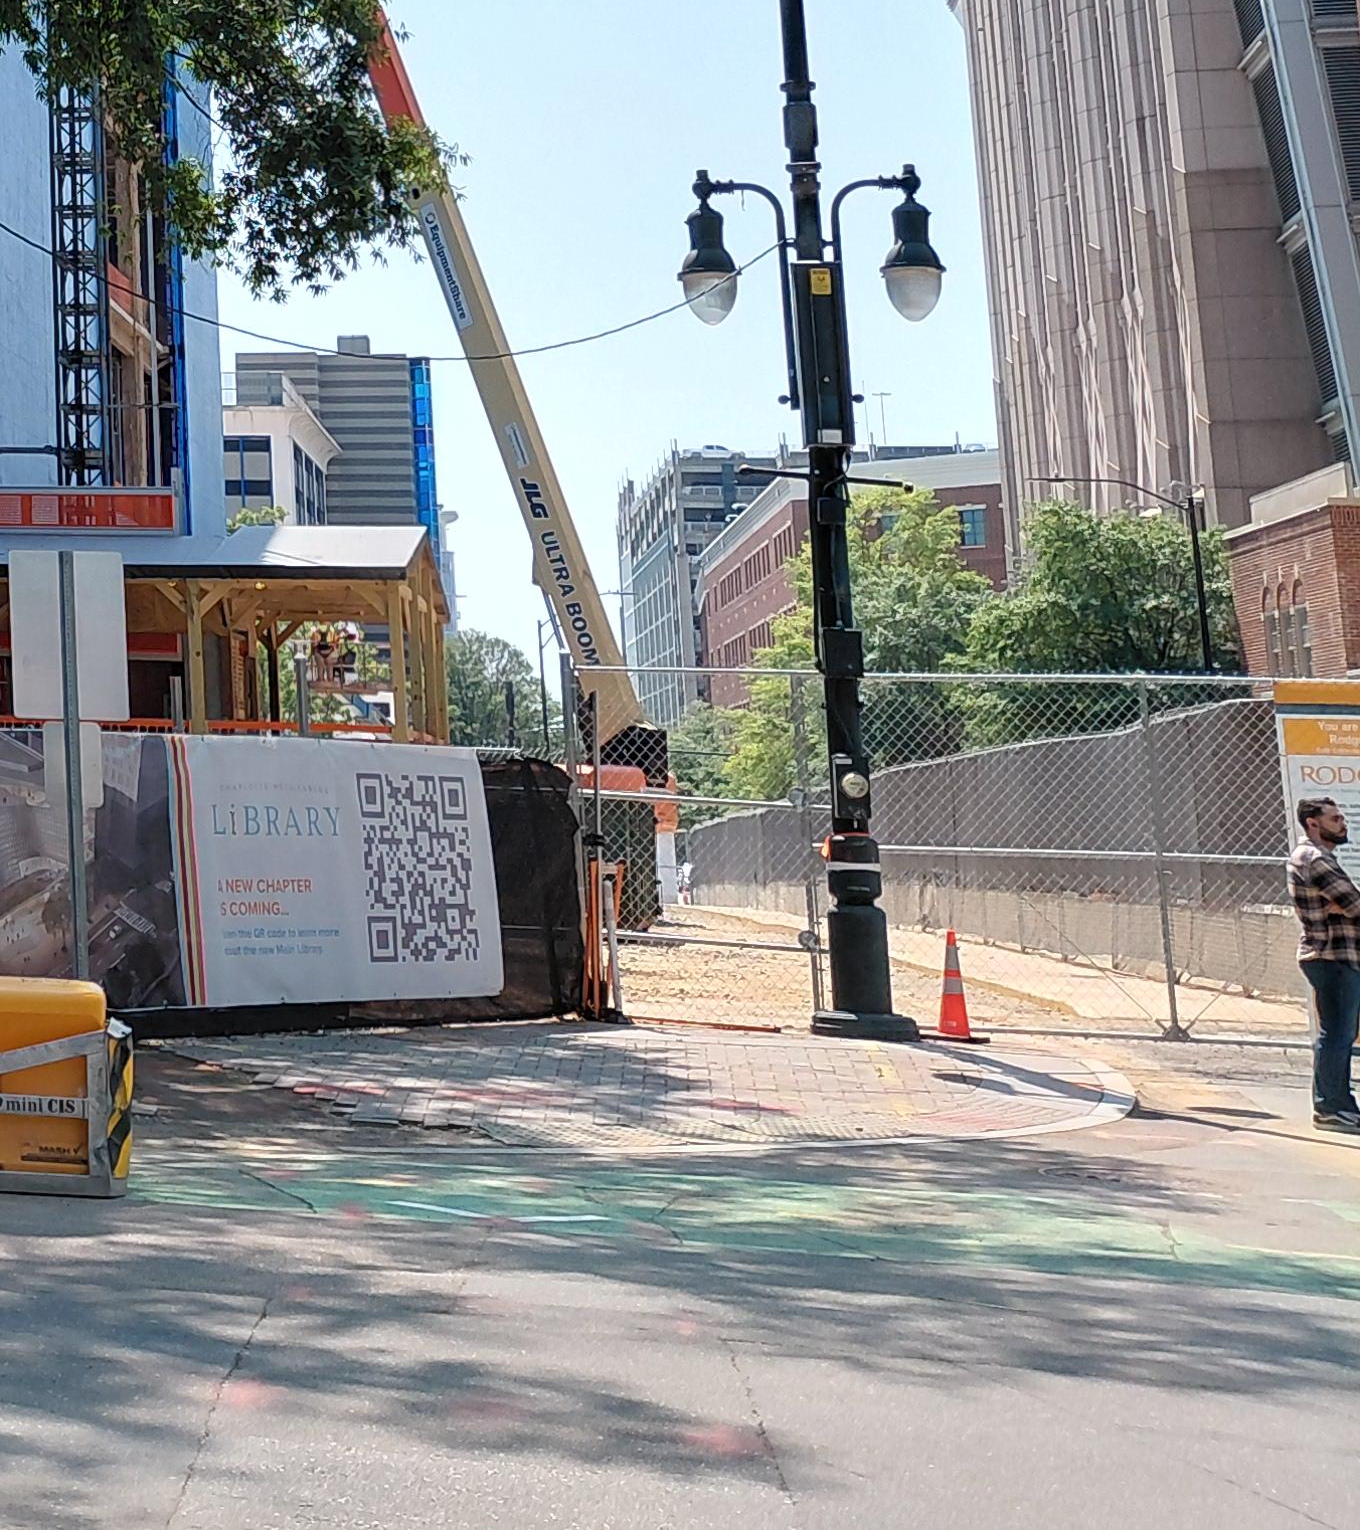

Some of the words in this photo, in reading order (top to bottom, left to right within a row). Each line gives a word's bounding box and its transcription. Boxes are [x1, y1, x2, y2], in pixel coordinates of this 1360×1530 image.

[429, 223, 467, 320] EquipmentShare
[520, 477, 550, 519] JLG
[540, 531, 576, 598] ULTRA
[565, 601, 601, 666] BOOM
[1318, 720, 1339, 731] You
[1341, 723, 1359, 732] are
[1300, 765, 1360, 786] ROD
[211, 803, 341, 837] LiBRARY
[217, 879, 224, 894] A
[225, 879, 253, 893] NEW
[256, 878, 312, 894] CHAPTER
[229, 901, 290, 917] COMING...
[5, 1097, 43, 1113] mini
[47, 1098, 76, 1114] CIS
